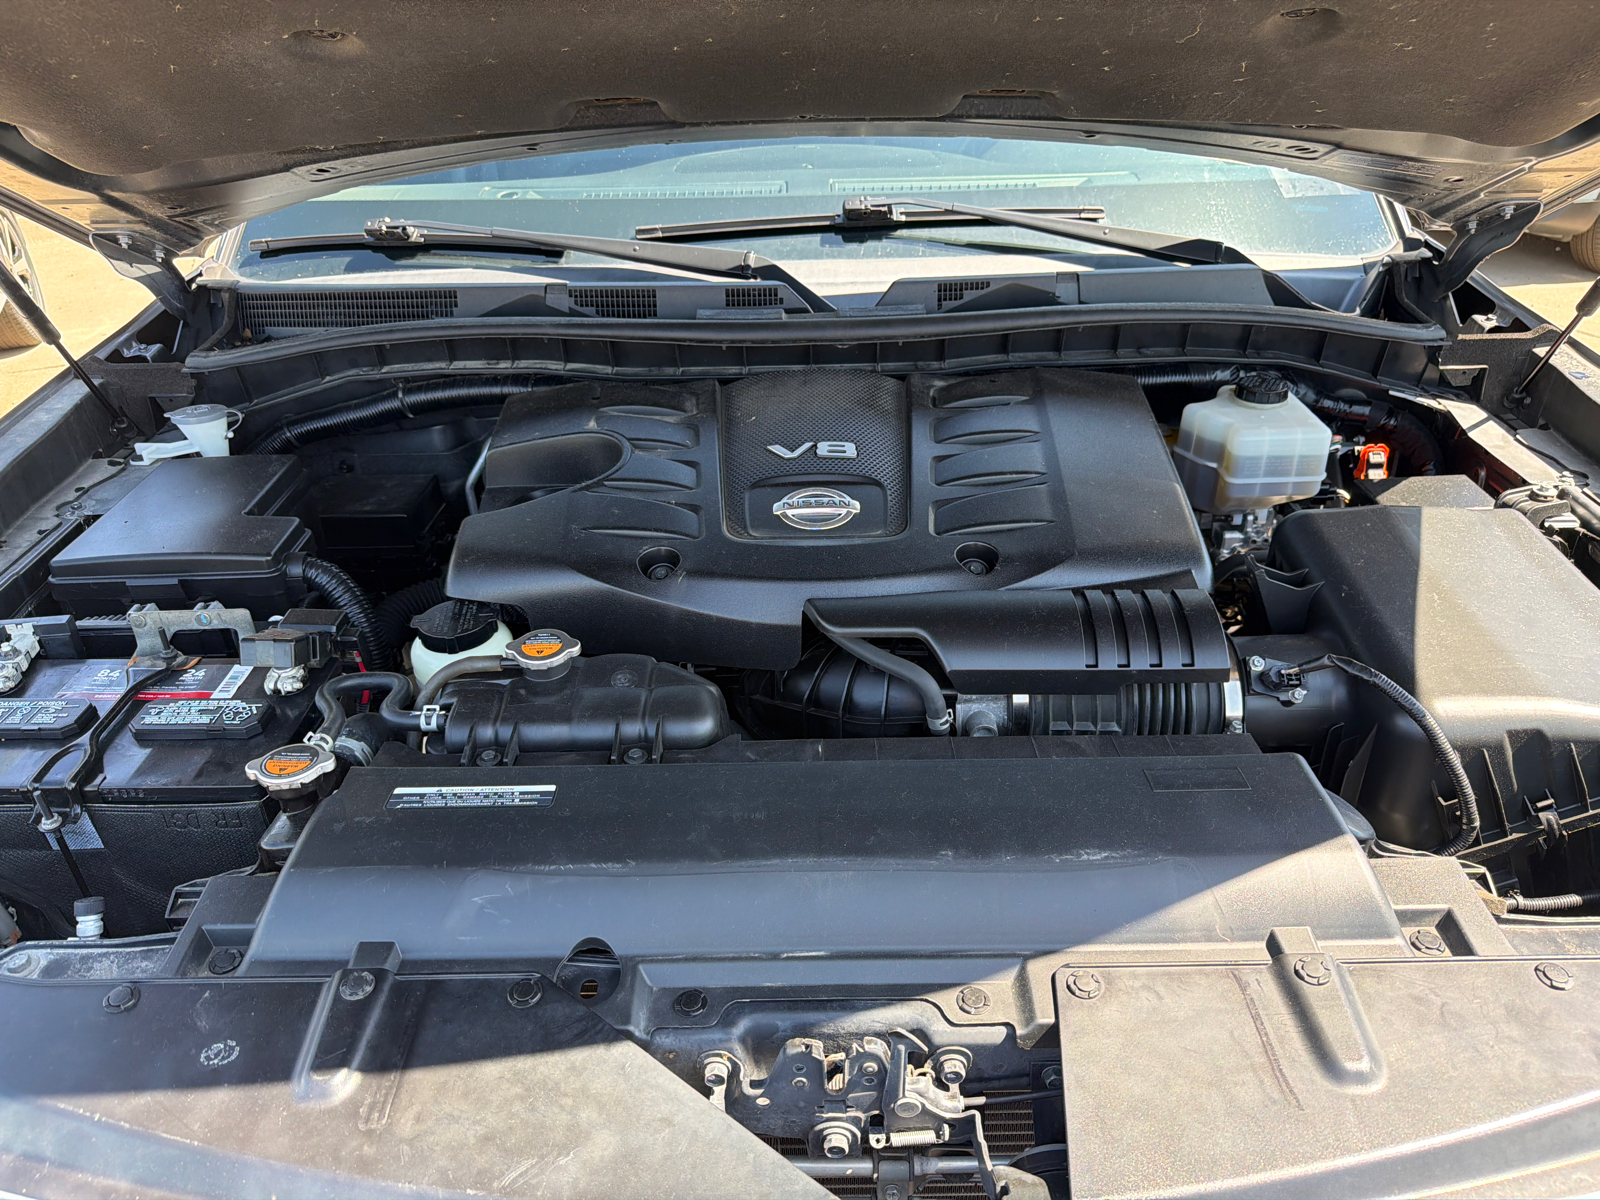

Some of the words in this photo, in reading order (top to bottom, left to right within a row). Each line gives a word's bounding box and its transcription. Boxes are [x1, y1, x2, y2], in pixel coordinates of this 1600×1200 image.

[766, 441, 858, 459] V8
[782, 499, 851, 509] NISSAN
[97, 669, 123, 677] 84
[183, 668, 207, 677] 24
